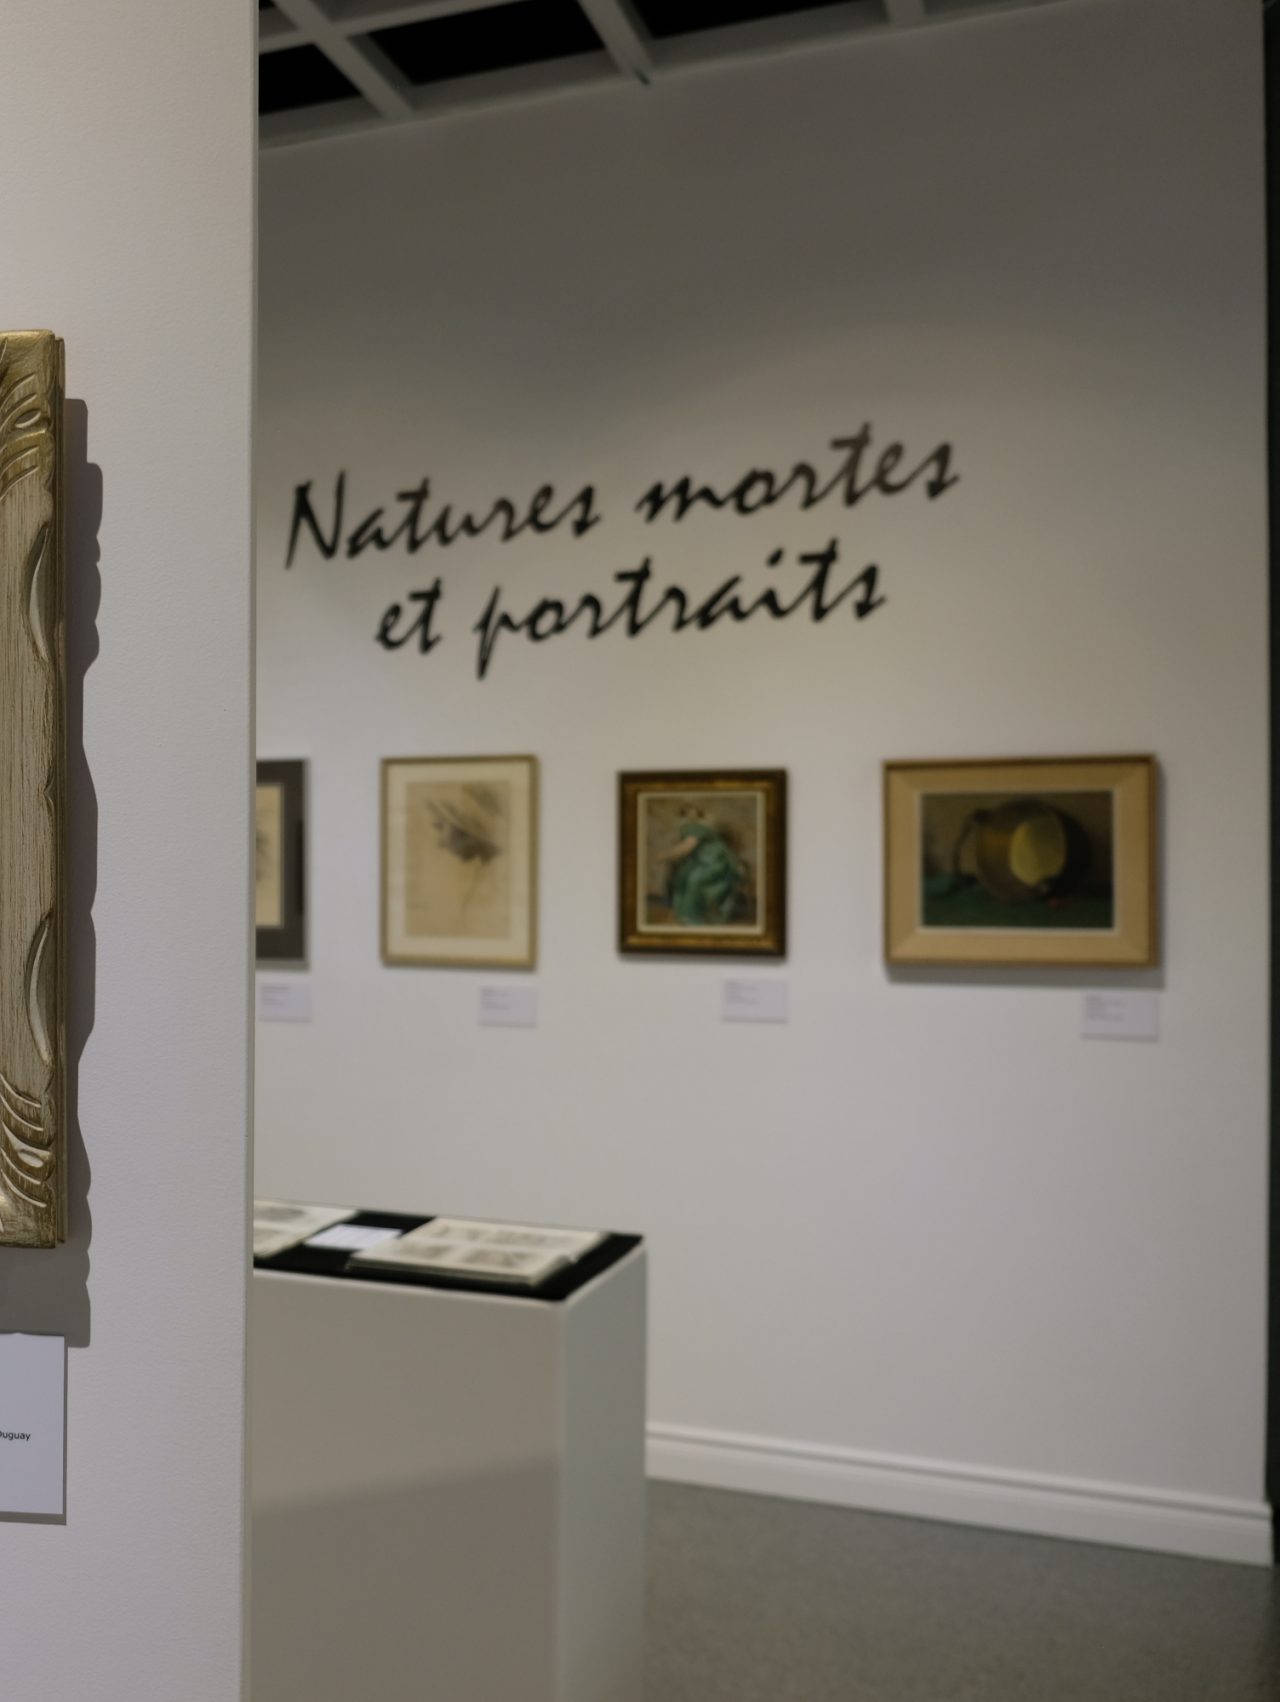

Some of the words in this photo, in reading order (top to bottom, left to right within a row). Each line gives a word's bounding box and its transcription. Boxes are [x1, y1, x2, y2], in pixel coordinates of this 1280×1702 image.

[285, 470, 601, 570] Natures
[634, 421, 961, 523] mortes
[375, 577, 444, 654] et
[472, 537, 887, 681] portraits
